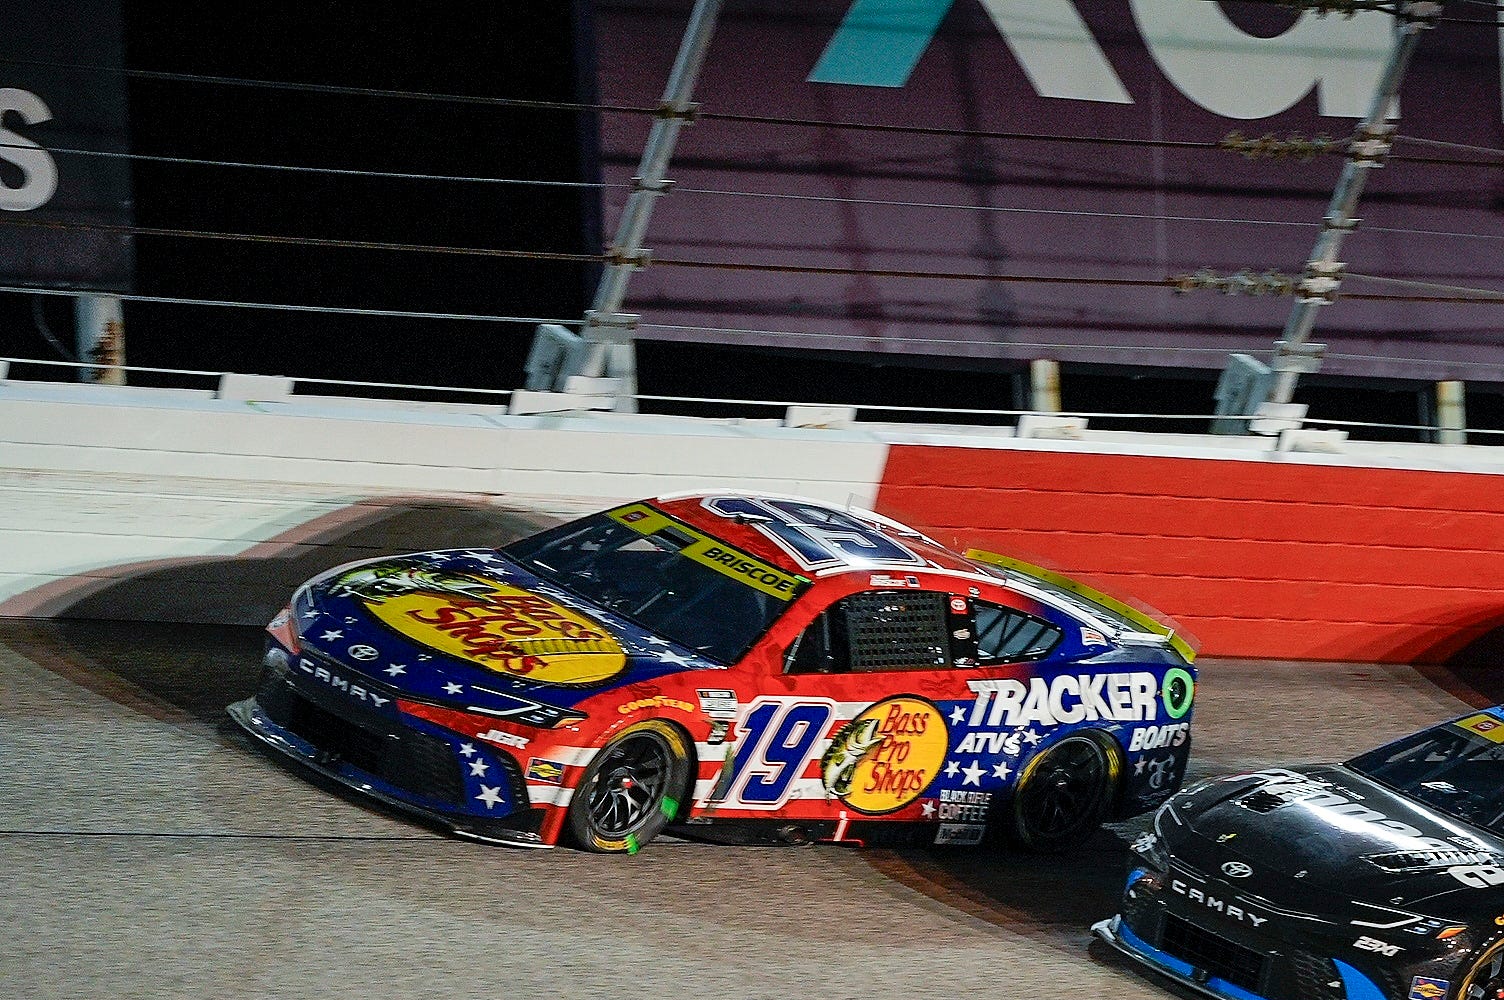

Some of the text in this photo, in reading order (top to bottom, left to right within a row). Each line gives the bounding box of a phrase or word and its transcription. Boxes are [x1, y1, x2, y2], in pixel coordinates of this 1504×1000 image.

[702, 547, 794, 592] BRISCOE
[299, 658, 391, 708] CAMRY
[617, 695, 695, 715] GOODYEAR
[966, 672, 1158, 727] TRACKER
[877, 703, 930, 735] Bass
[476, 729, 530, 750] JGR
[722, 700, 830, 805] 19
[871, 734, 911, 763] Pro
[1128, 722, 1190, 752] BOATS
[863, 762, 926, 799] Shops
[940, 789, 968, 803] BLACK
[938, 803, 990, 822] COFFEE
[1171, 879, 1269, 928] CAMRY
